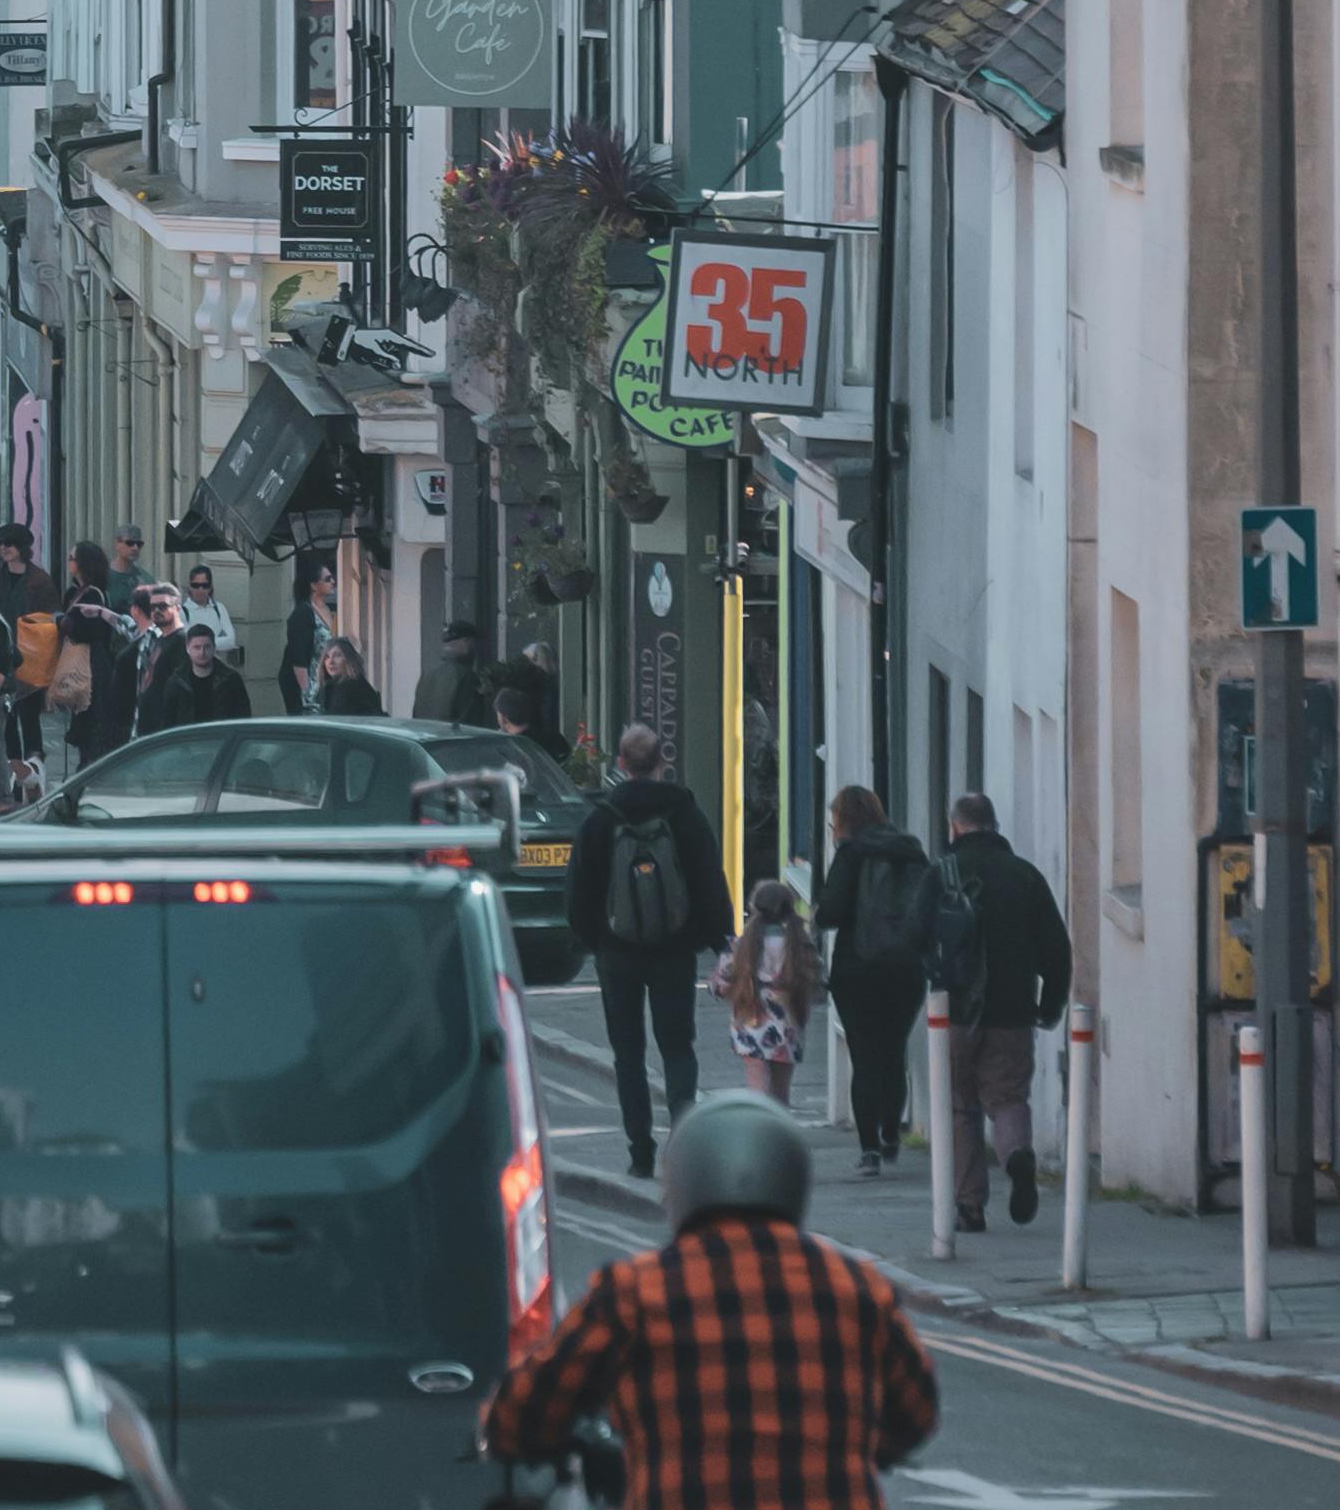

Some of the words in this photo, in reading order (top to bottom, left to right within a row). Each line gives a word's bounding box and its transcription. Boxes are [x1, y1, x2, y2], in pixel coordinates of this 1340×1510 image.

[321, 165, 338, 173] THE
[295, 176, 365, 191] DORSET
[303, 207, 323, 215] FREE
[326, 207, 356, 215] HOUSE
[686, 263, 808, 375] 35
[684, 351, 804, 387] NORTH
[669, 412, 734, 438] CAFE
[640, 648, 654, 721] GUEST
